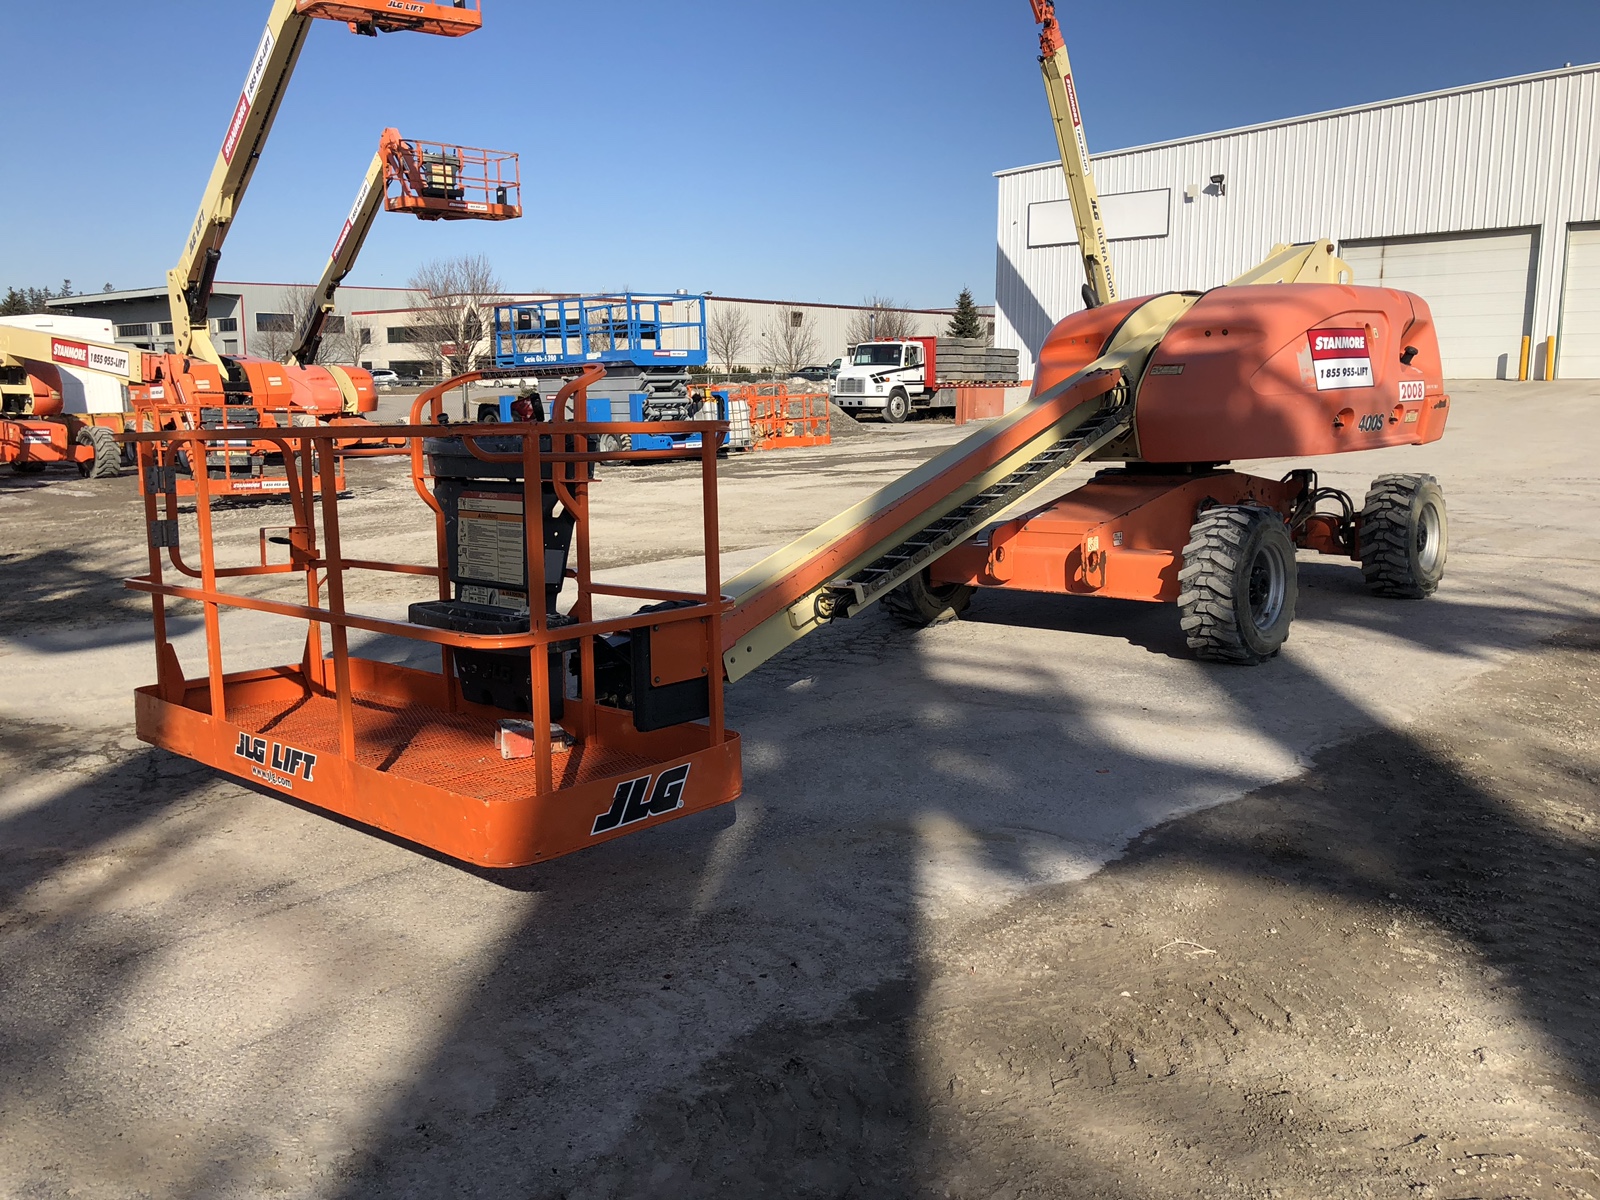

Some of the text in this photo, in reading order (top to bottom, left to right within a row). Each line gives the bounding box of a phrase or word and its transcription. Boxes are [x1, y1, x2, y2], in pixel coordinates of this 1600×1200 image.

[387, 0, 424, 13] JLG LIFT
[1065, 78, 1078, 123] STANMORE
[224, 98, 247, 159] STANMORE
[189, 208, 205, 256] JLG LIFT
[1090, 197, 1115, 298] JLG ULTRA BOOM
[53, 342, 87, 361] STANMORE
[93, 353, 103, 364] 855
[104, 355, 126, 368] 955-LIFT
[1315, 336, 1365, 351] STANMORE
[1320, 366, 1368, 379] 1 855 955-LIFT
[1401, 383, 1422, 399] 2008
[1358, 413, 1384, 432] 400S
[234, 731, 317, 782] JLG LIFT
[251, 765, 292, 789] www.jlg.com
[590, 762, 691, 836] JLG
